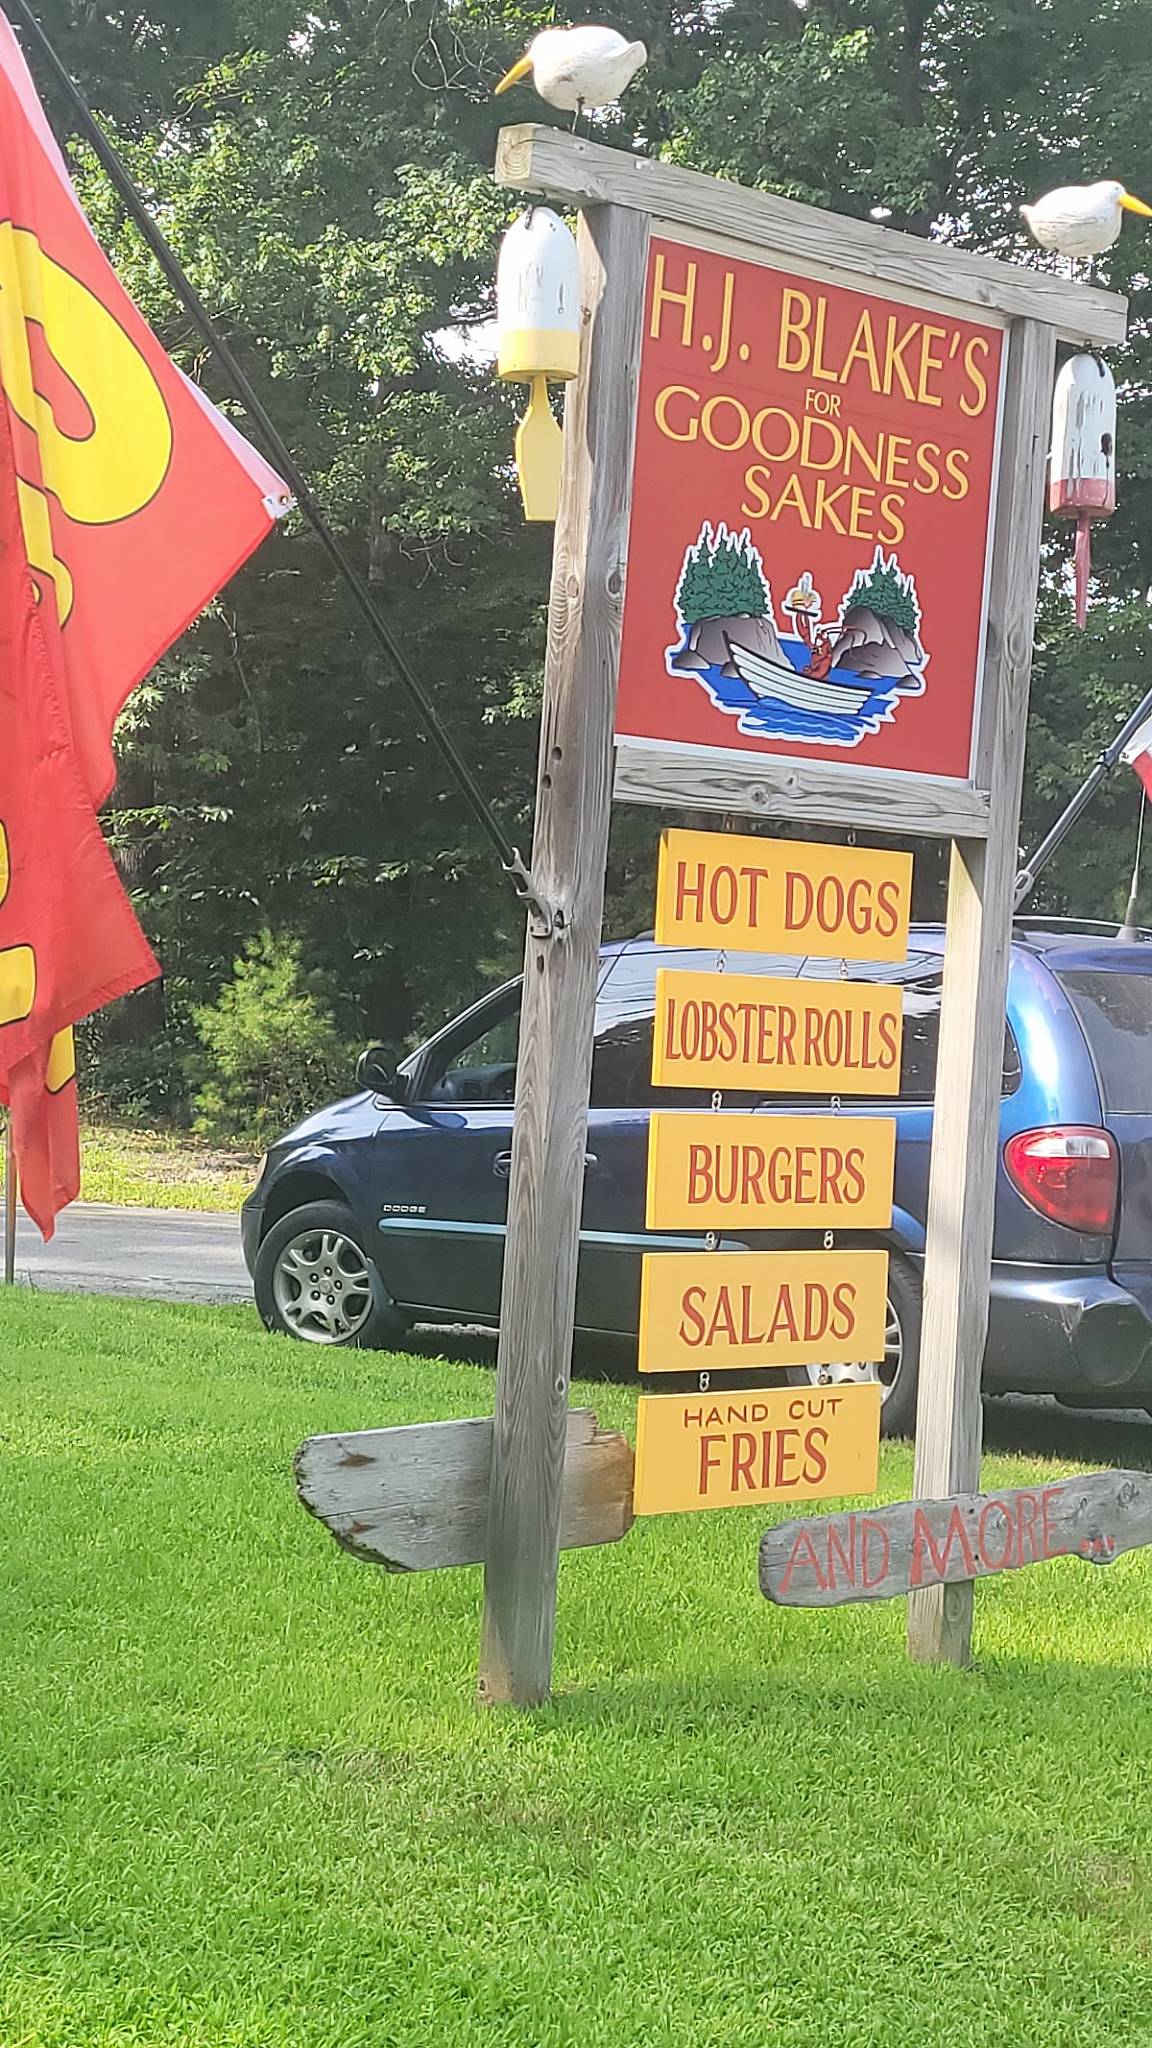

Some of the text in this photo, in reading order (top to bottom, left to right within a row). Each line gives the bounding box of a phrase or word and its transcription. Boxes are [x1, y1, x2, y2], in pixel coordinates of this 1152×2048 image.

[650, 254, 989, 417] H.J. BLAKE'S
[804, 388, 841, 418] FOR
[653, 385, 970, 500] GOODNESS
[741, 465, 905, 545] SAKES
[675, 861, 900, 937] HOT DOGS
[665, 998, 897, 1069] LOBSTER ROLLS
[687, 1144, 866, 1205] BURGERS
[679, 1283, 857, 1347] SALADS
[684, 1398, 844, 1428] HAND CUT
[698, 1427, 829, 1495] FRIES
[779, 1516, 889, 1593] AND
